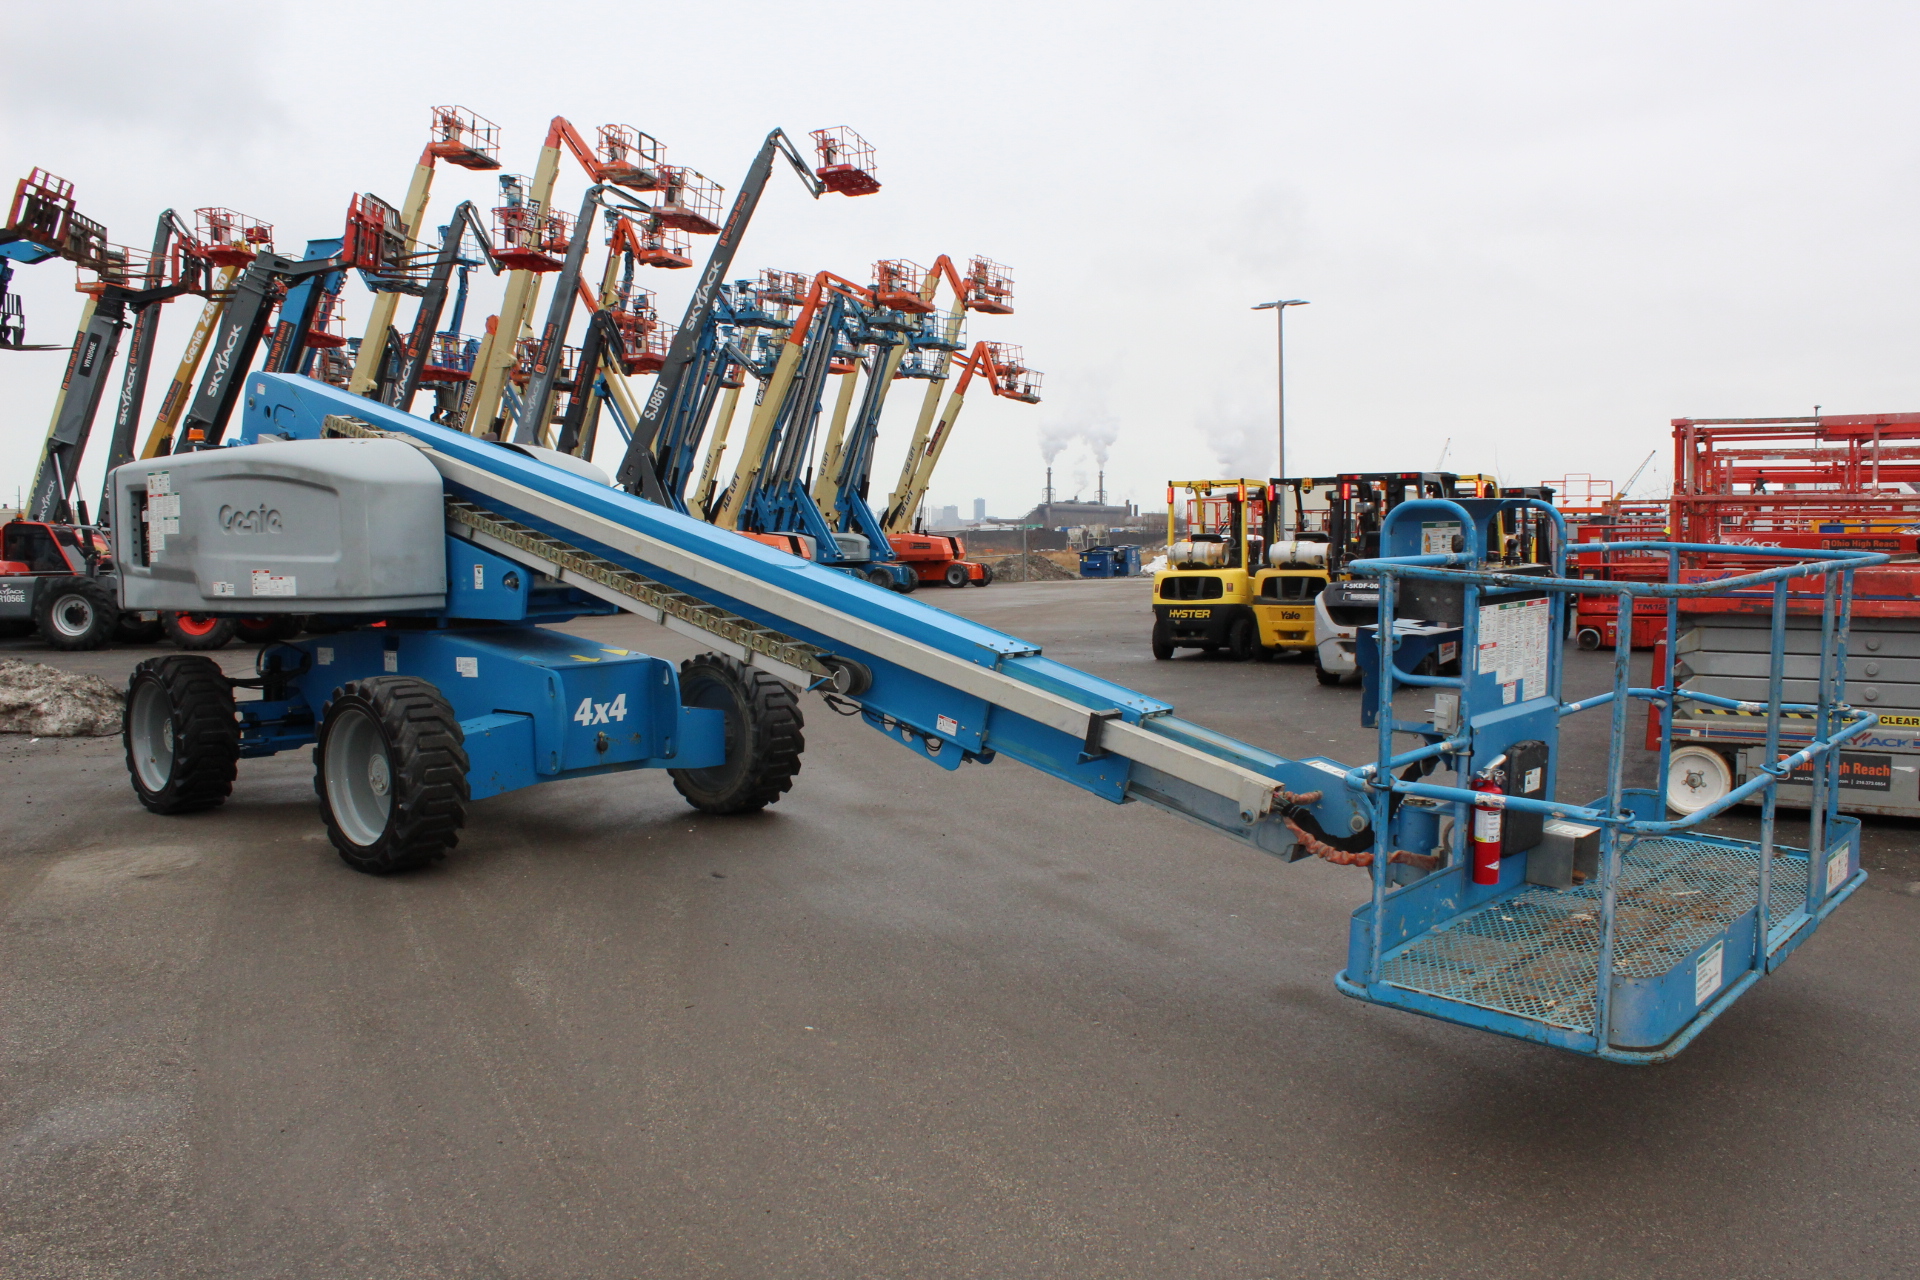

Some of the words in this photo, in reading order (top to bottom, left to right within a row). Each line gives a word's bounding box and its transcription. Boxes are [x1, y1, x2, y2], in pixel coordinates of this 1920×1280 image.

[736, 192, 748, 212] Reach
[686, 260, 723, 331] SKYJACK
[275, 321, 288, 342] Reach
[184, 330, 205, 364] Genie
[270, 342, 282, 358] High
[207, 324, 243, 398] SKYJACK
[393, 358, 414, 408] KYJACK
[119, 366, 137, 425] SKYJACK
[644, 381, 668, 421] SJ86T
[705, 454, 713, 469] LIFT
[908, 446, 916, 462] LIFT
[39, 480, 56, 522] SKYJACK
[723, 494, 732, 512] JLG
[730, 473, 740, 494] LIFT
[904, 490, 913, 505] LIFT
[219, 503, 283, 535] Genie
[1852, 540, 1871, 548] High
[1873, 540, 1899, 548] Reach
[1169, 609, 1211, 618] HYSTER
[1281, 611, 1300, 620] Yale
[574, 693, 627, 726] 4x4
[1880, 716, 1920, 726] CLEAR
[1843, 732, 1909, 748] YJACK
[1853, 762, 1891, 777] Reach
